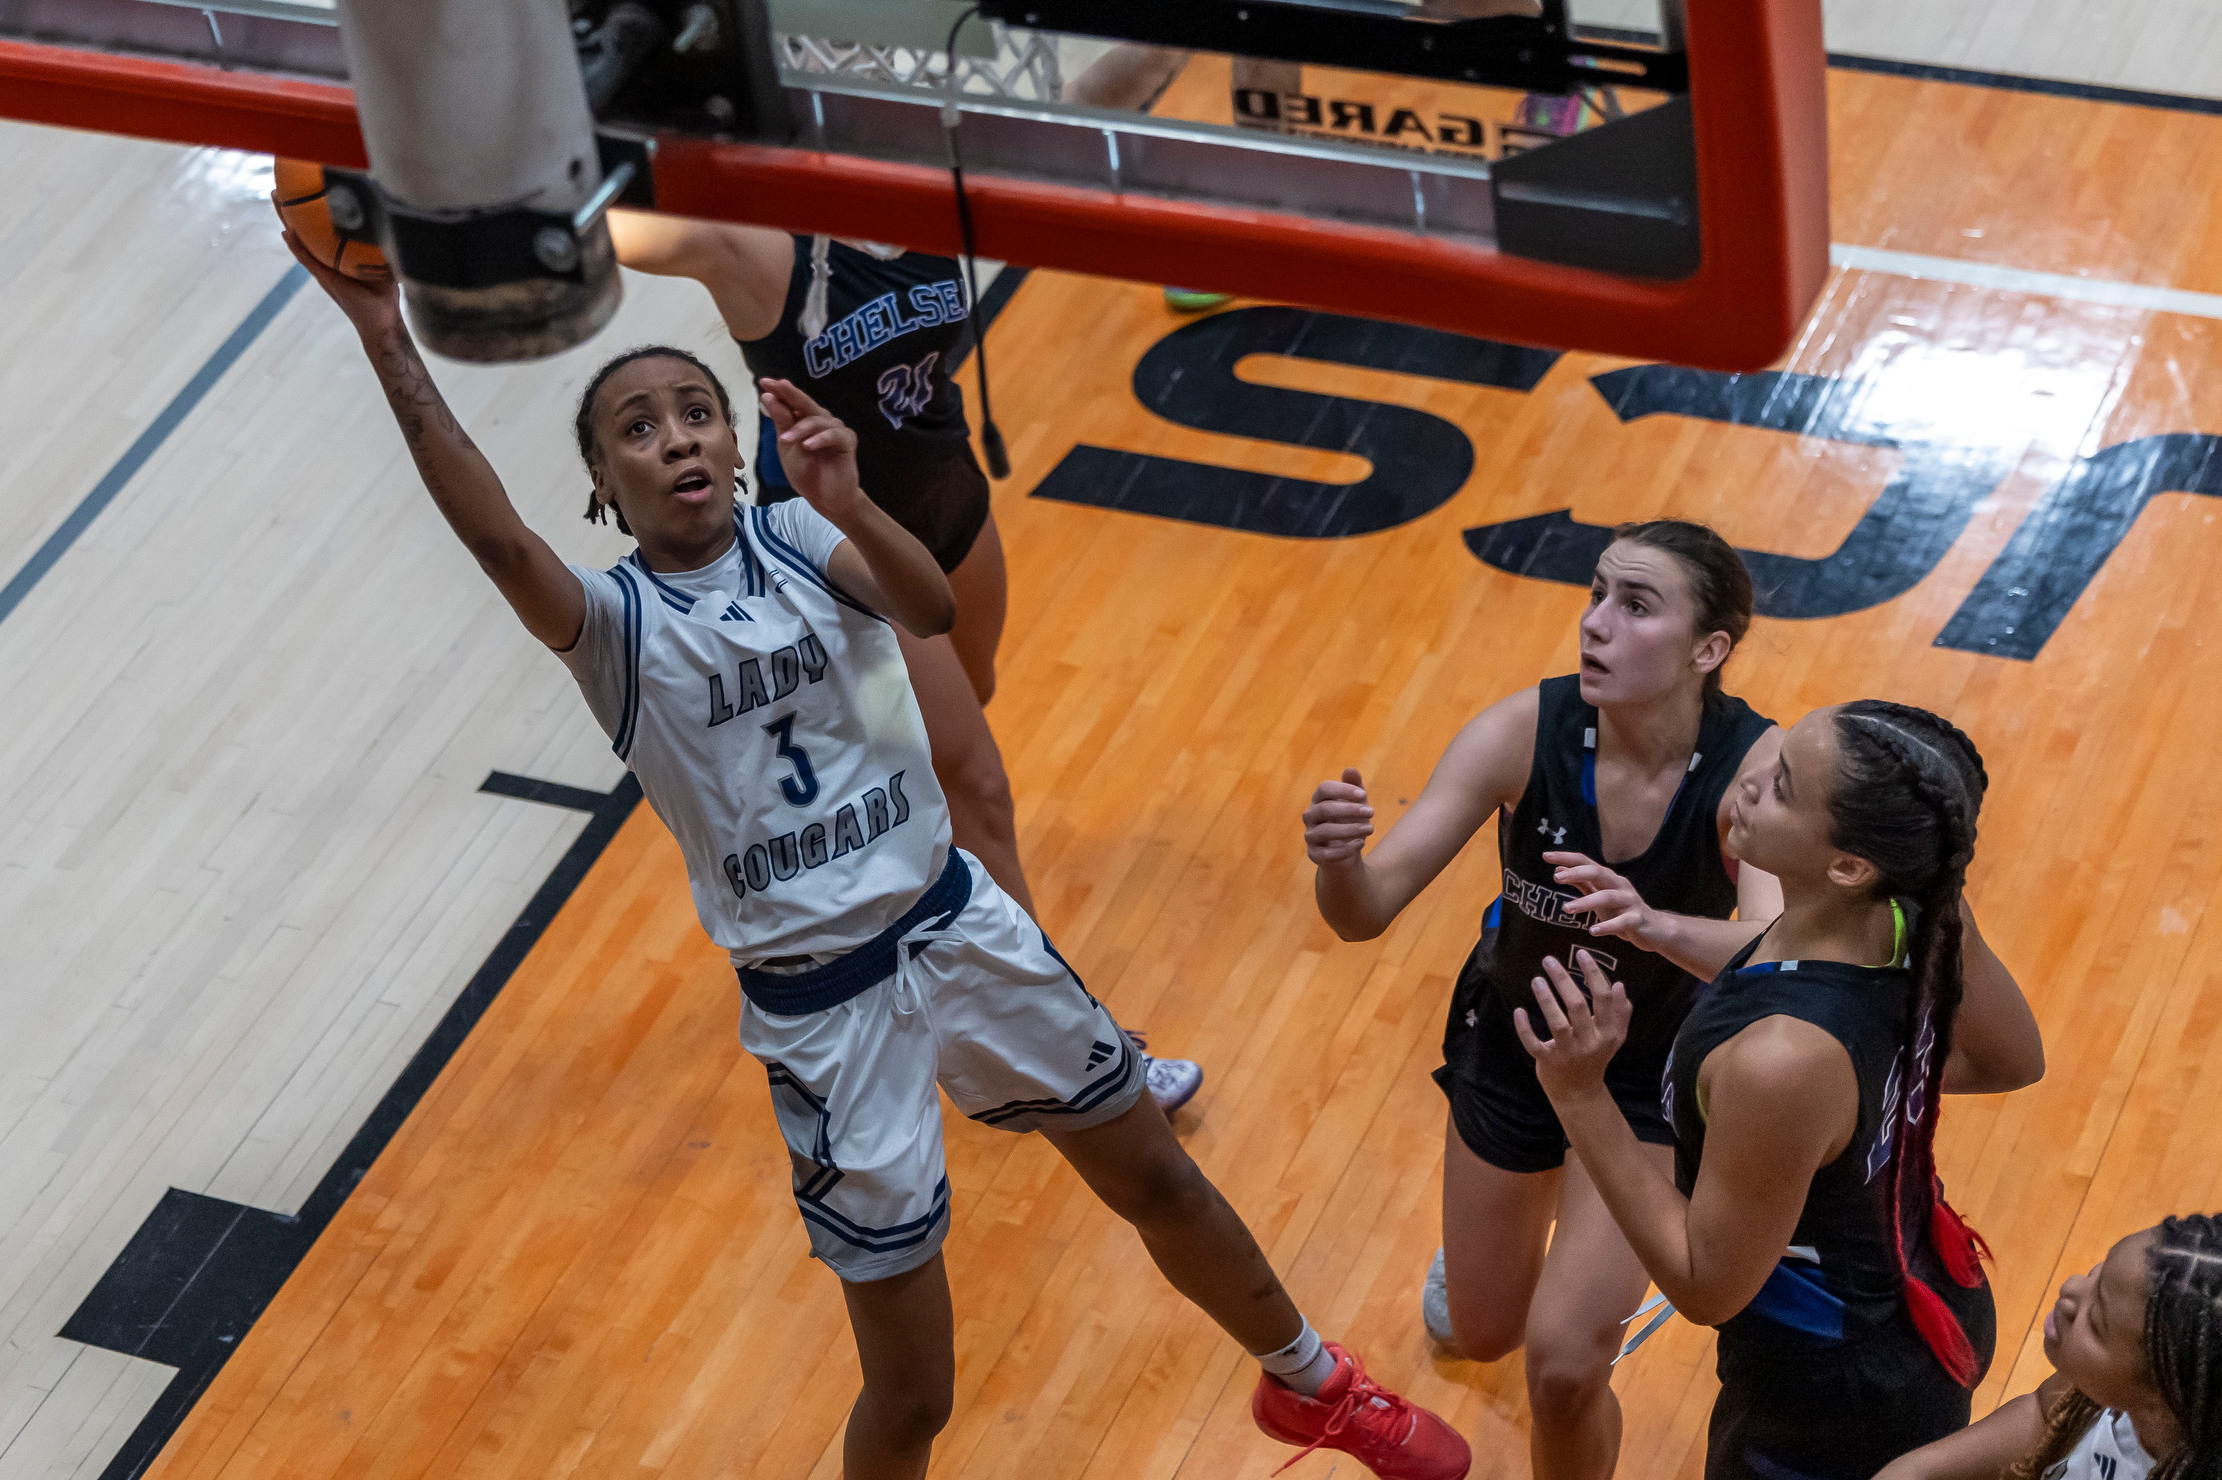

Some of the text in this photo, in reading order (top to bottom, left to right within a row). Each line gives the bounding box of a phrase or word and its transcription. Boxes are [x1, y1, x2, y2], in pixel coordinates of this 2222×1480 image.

[803, 279, 970, 379] CHELSE
[707, 632, 828, 728] LADY
[760, 709, 821, 809] 3
[722, 769, 910, 900] COUGARS
